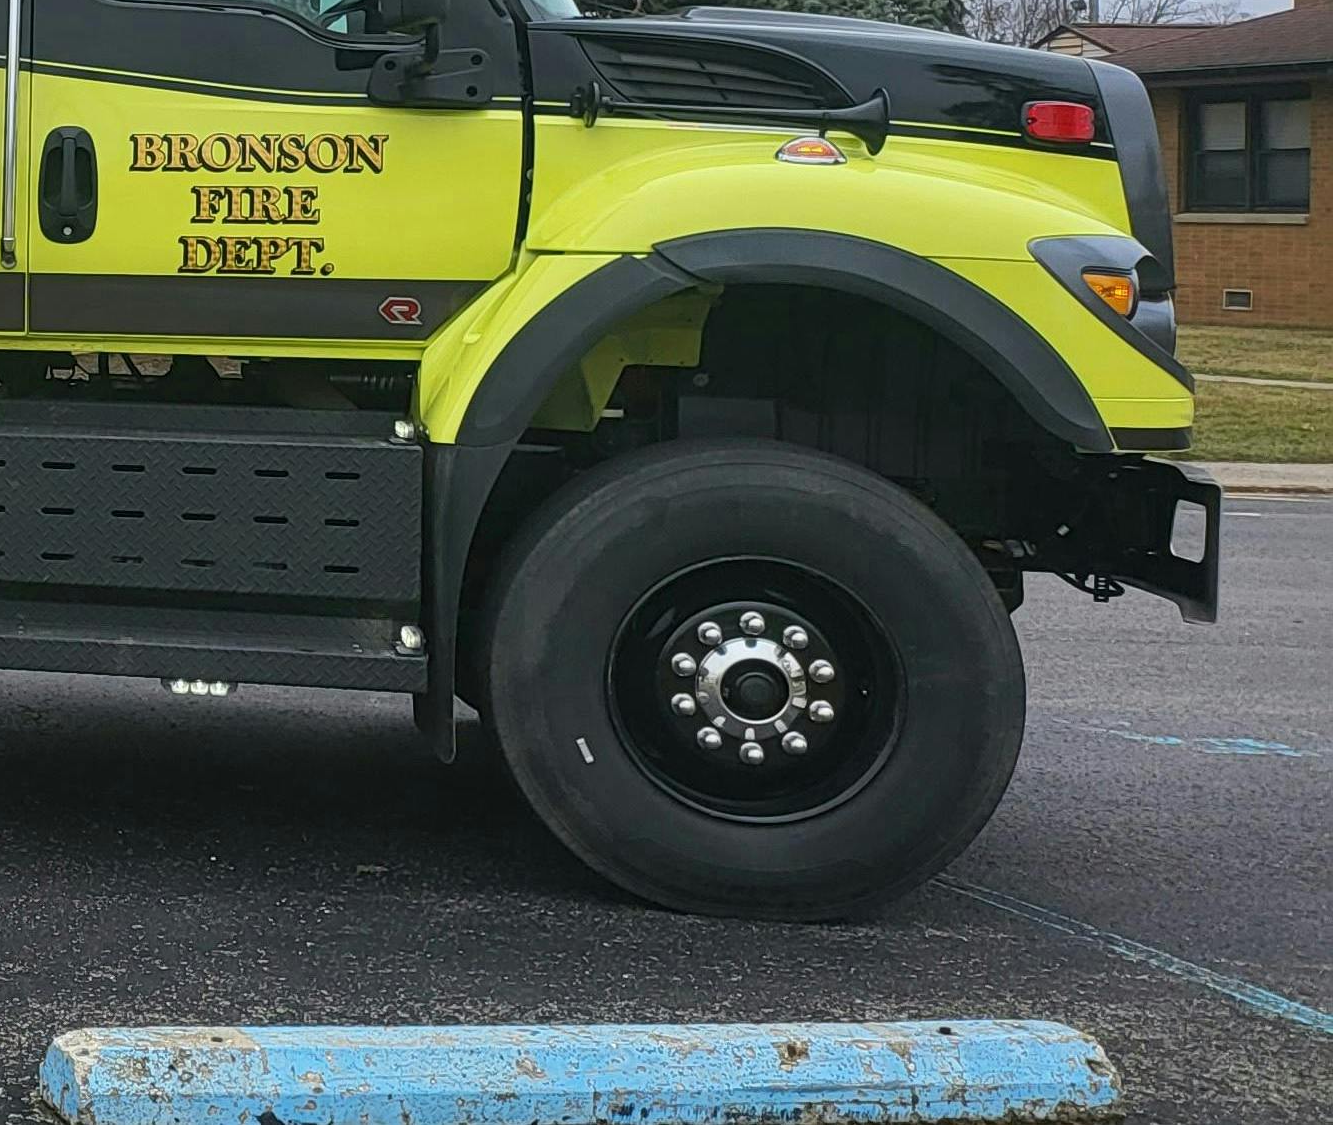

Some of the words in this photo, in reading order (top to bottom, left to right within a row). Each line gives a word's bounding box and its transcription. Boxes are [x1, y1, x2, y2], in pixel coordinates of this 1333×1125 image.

[130, 133, 389, 174] BRONSON
[191, 185, 320, 225] FIRE
[178, 236, 335, 276] DEPT.
